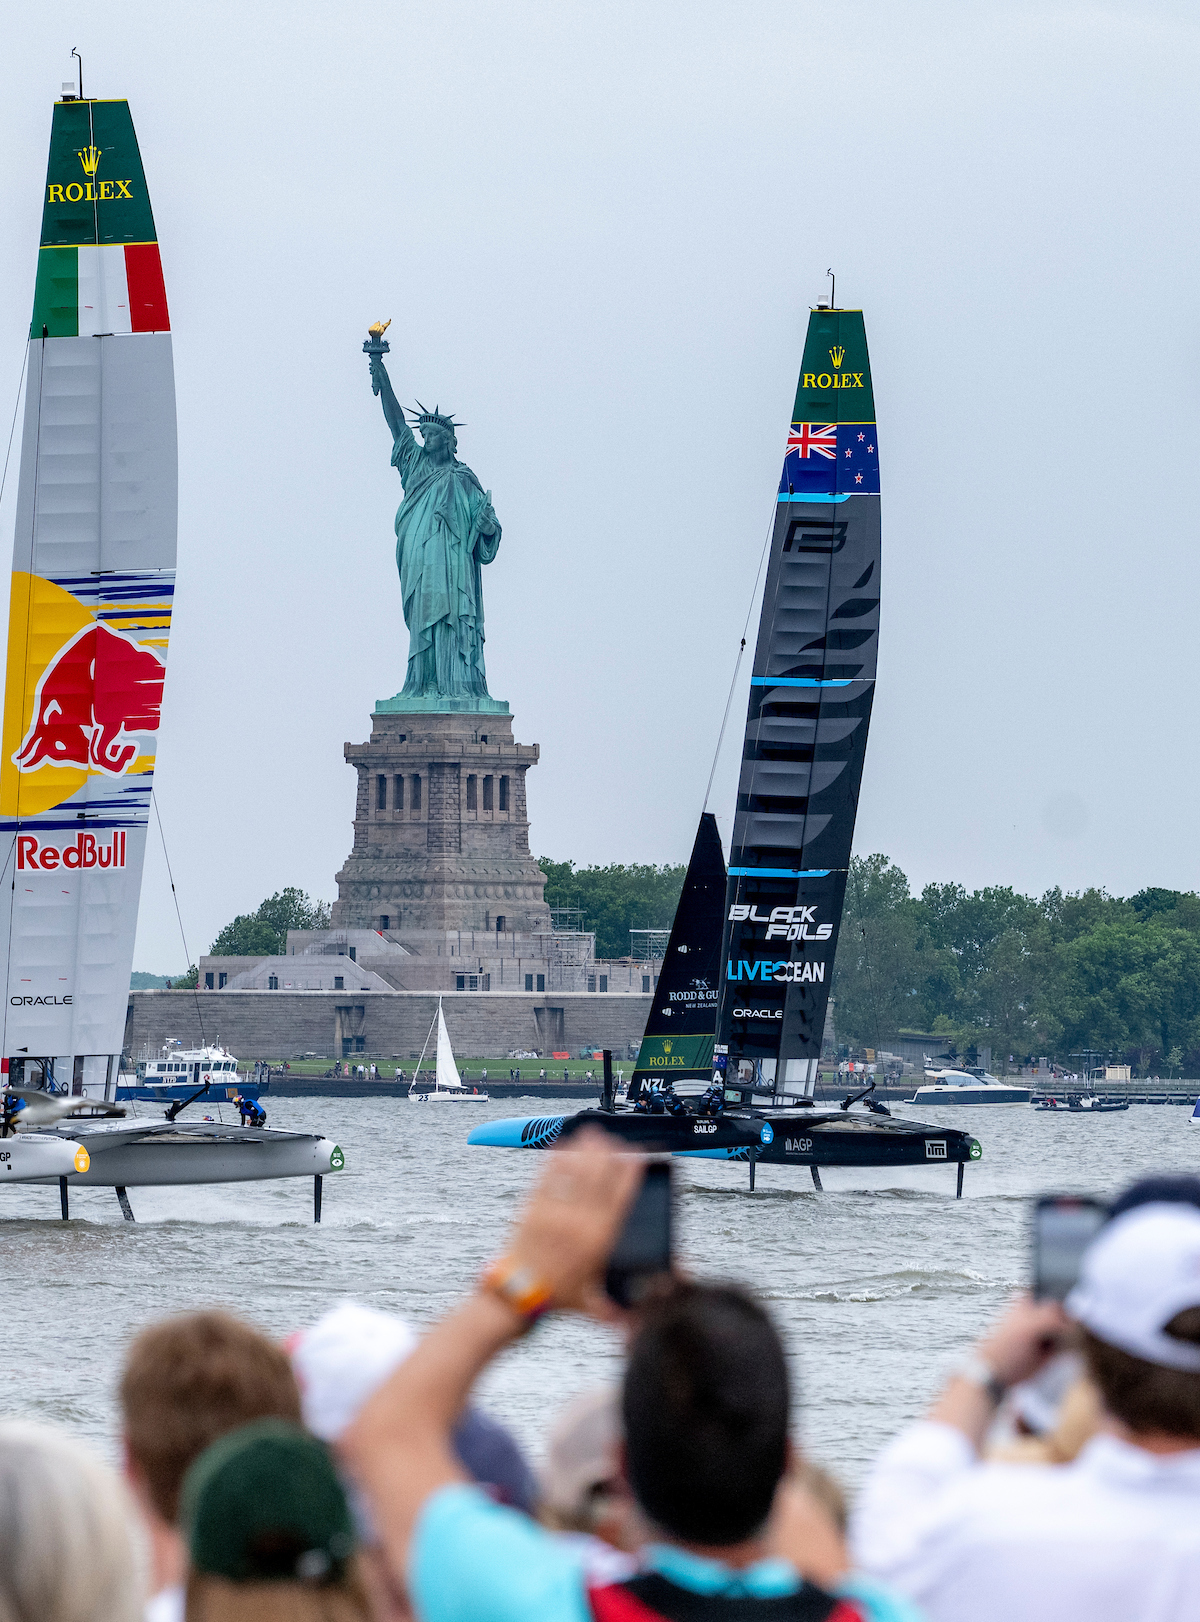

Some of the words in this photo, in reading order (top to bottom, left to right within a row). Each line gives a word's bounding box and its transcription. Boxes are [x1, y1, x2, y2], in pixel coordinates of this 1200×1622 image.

[48, 179, 133, 203] ROLEX
[802, 372, 864, 389] ROLEX
[728, 904, 818, 923] BLACK
[765, 923, 833, 941] FOILS
[10, 995, 73, 1006] ORACLE
[669, 991, 697, 1001] RODD
[705, 990, 719, 1000] GU
[733, 1009, 783, 1019] ORACLE
[649, 1056, 685, 1066] ROLEX
[418, 1094, 429, 1102] 23
[693, 1124, 717, 1134] SAILGP
[792, 1138, 813, 1151] AGP
